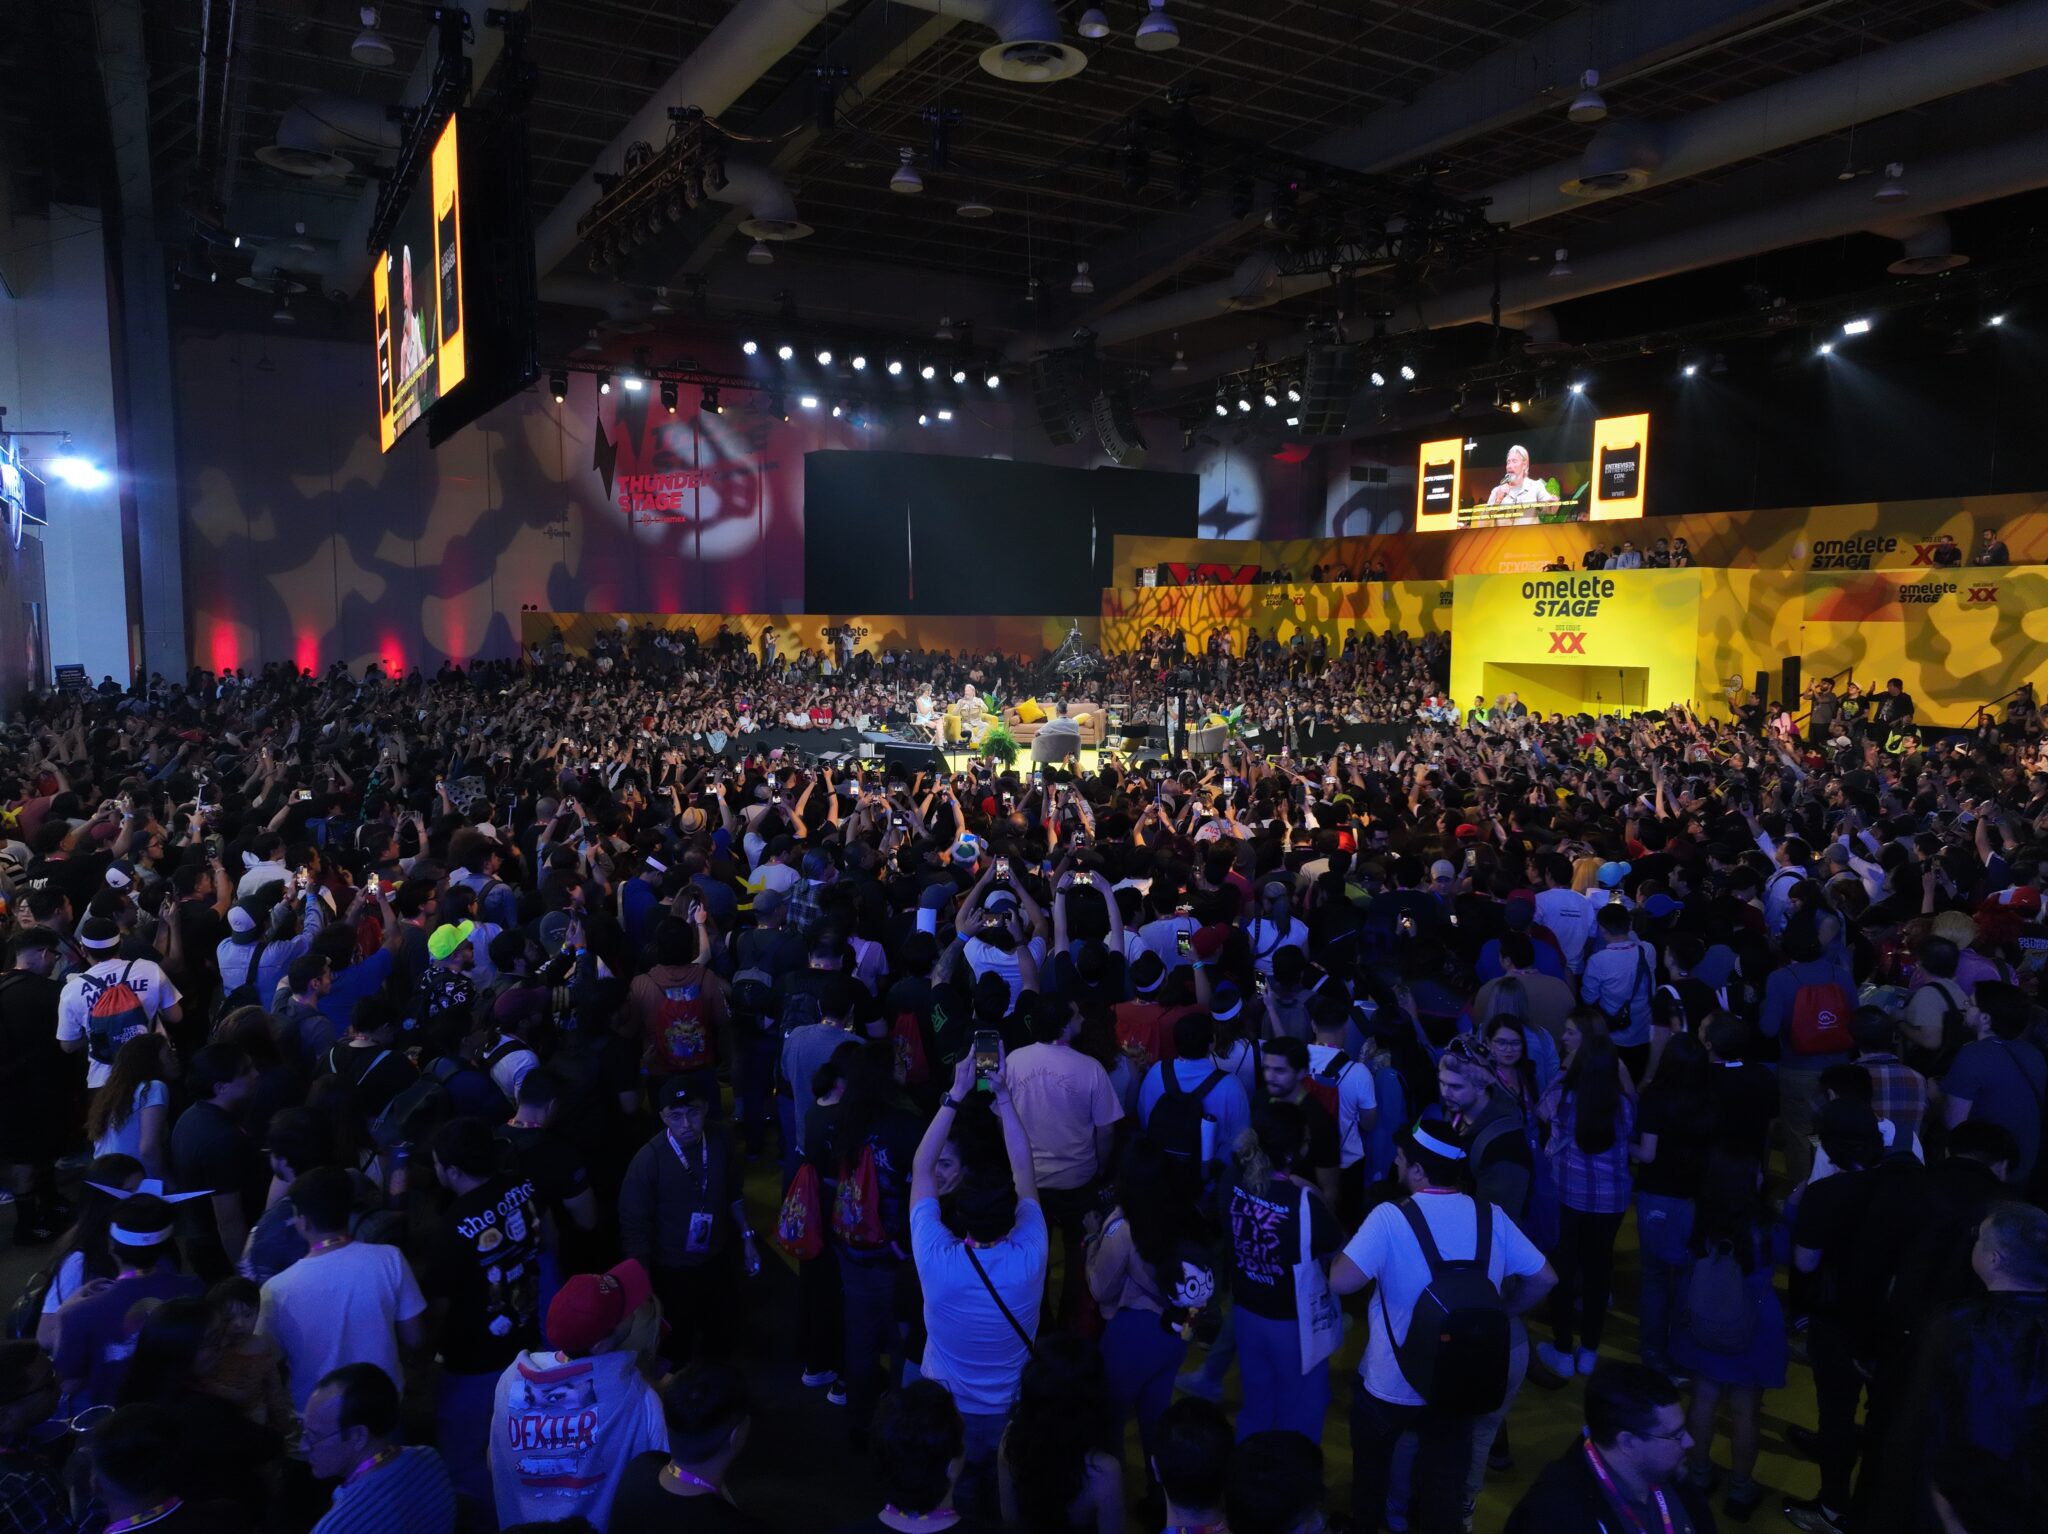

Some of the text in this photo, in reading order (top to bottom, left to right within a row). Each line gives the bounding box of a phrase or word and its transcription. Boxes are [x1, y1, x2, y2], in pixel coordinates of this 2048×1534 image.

[617, 470, 713, 493] THUNDER
[617, 491, 684, 512] STAGE
[1813, 536, 1897, 554] omelete
[1811, 555, 1872, 570] STAGE
[1522, 576, 1615, 599] omelete
[1900, 582, 1957, 594] omelete
[1967, 588, 1999, 602] XX
[1533, 600, 1600, 617] STAGE
[1899, 595, 1941, 603] STAGE
[1548, 632, 1588, 654] XX
[457, 1209, 496, 1240] the
[497, 1177, 536, 1217] offic
[509, 1410, 597, 1450] DEXTER
